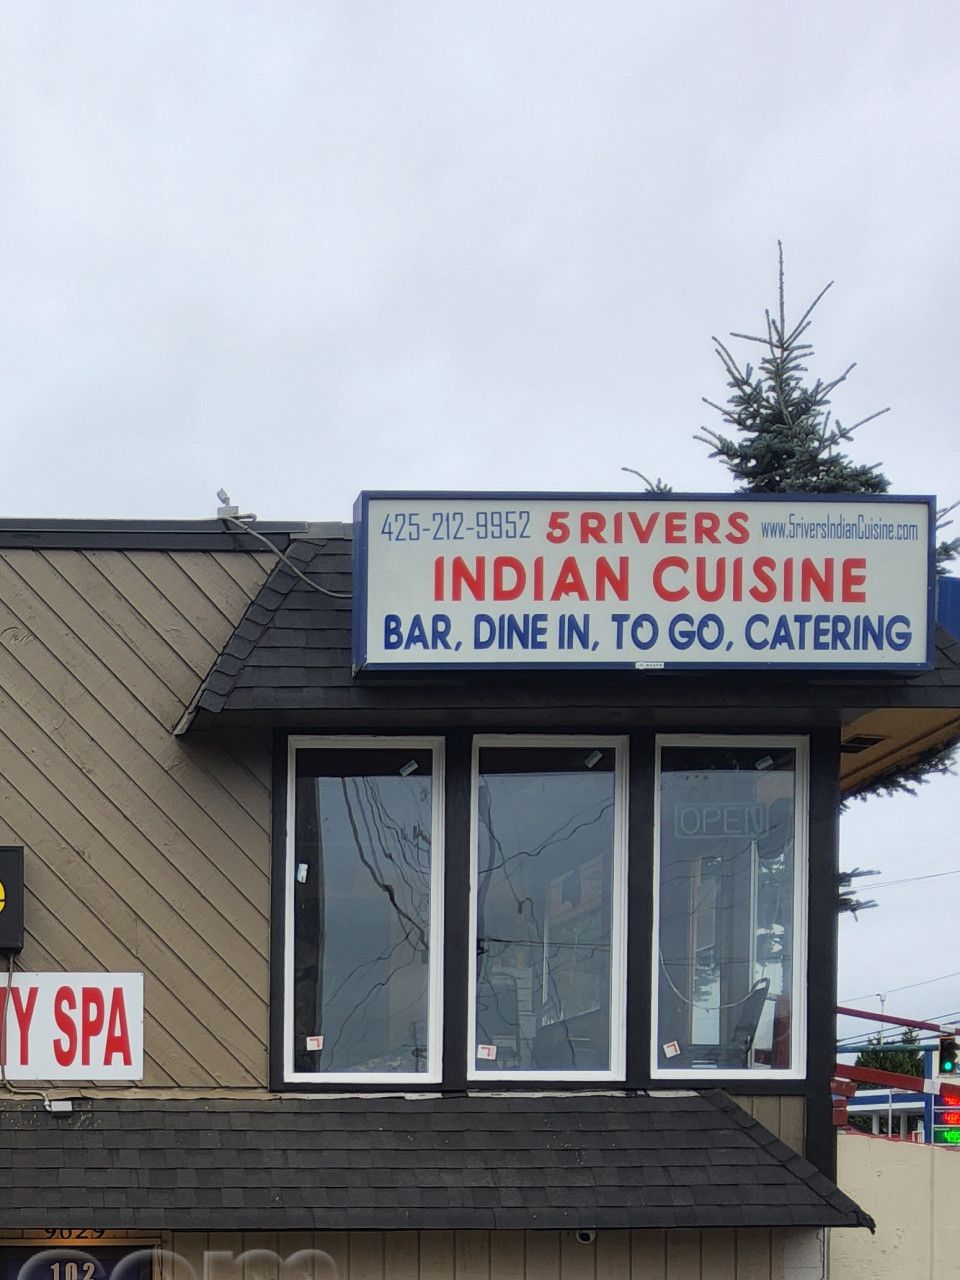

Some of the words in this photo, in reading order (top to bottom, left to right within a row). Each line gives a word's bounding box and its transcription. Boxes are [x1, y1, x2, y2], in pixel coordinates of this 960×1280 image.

[381, 511, 531, 541] 425-212-9952
[761, 513, 919, 541] www.5riversIndianCuisine.com
[433, 555, 630, 602] INDIAN
[652, 556, 867, 603] CUISINE
[384, 613, 460, 652] BAR,
[473, 613, 547, 650] DINE
[558, 613, 598, 652] IN,
[611, 613, 658, 650] TO
[669, 613, 732, 652] GO,
[744, 613, 913, 652] CATERING
[680, 805, 764, 834] OPEN
[53, 986, 132, 1068] SPA
